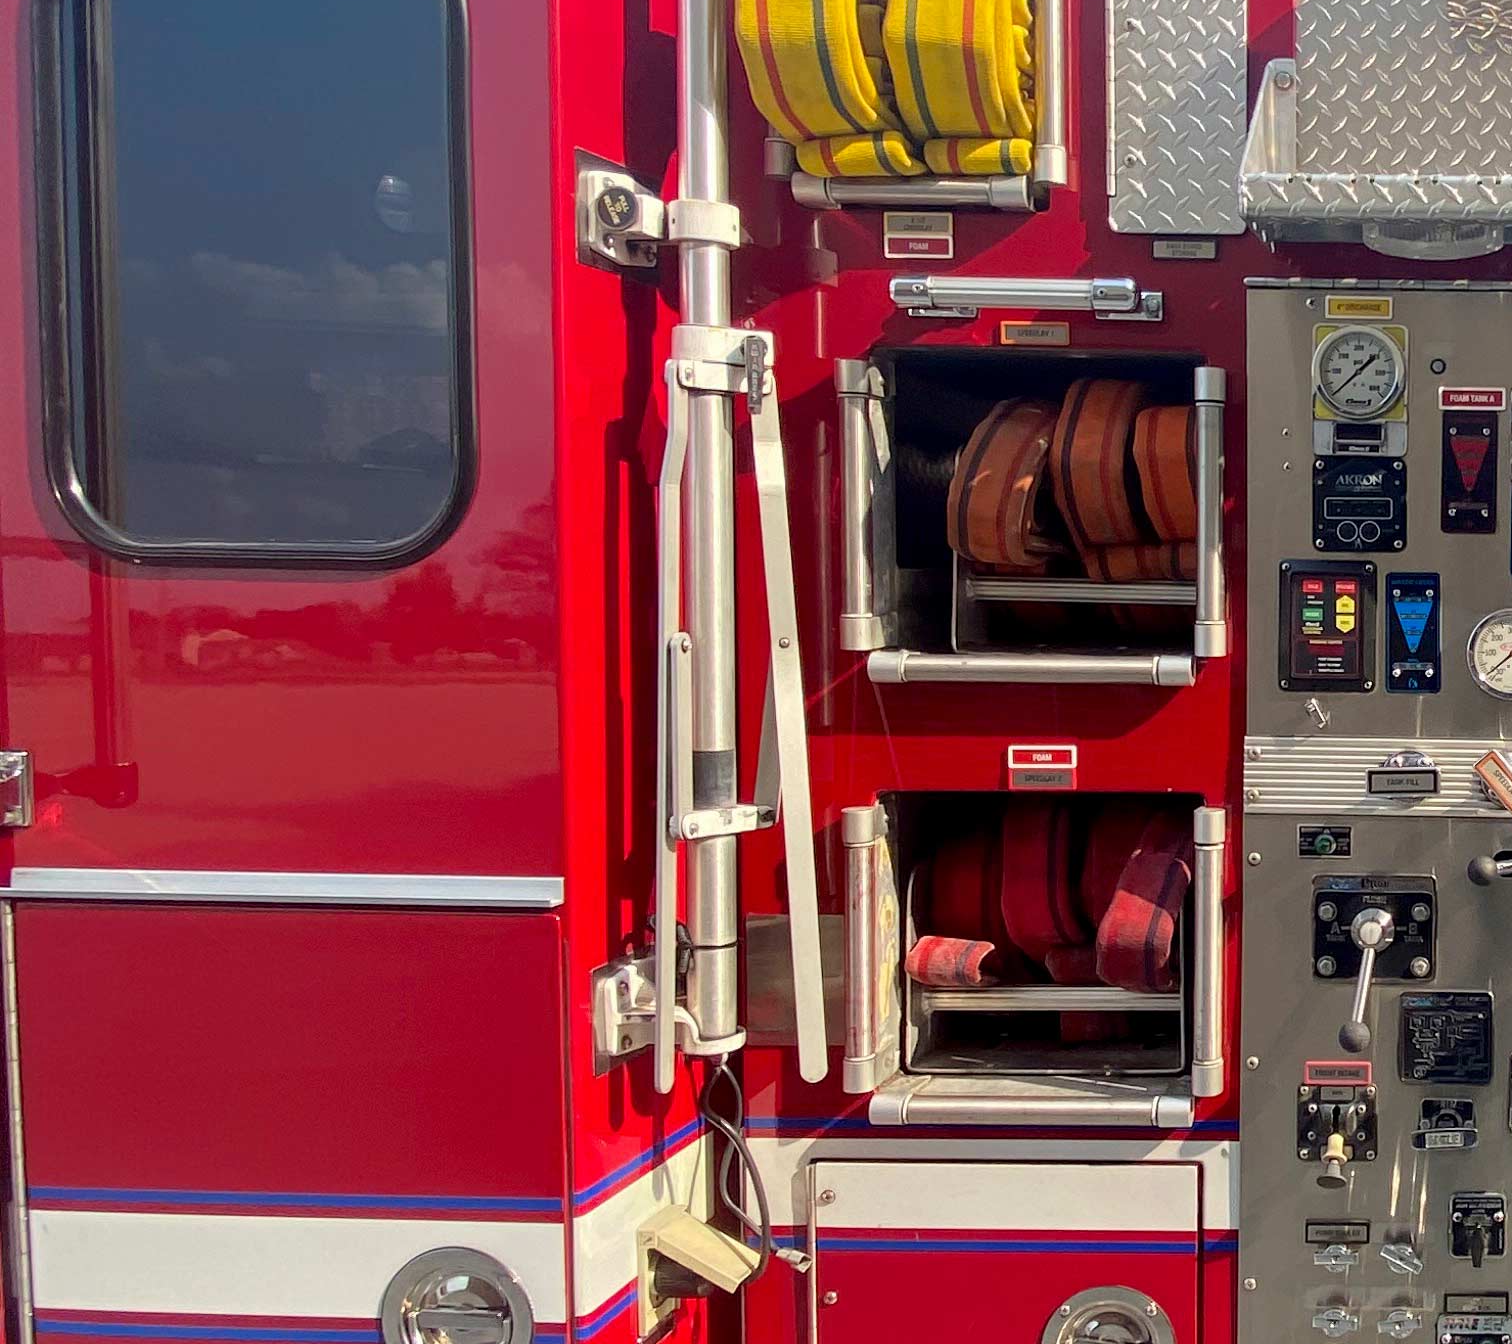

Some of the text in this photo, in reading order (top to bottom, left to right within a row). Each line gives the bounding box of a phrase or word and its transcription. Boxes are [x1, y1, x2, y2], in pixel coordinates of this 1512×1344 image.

[908, 241, 929, 251] FOAM
[1449, 394, 1495, 403] FOAM TANK A
[1335, 474, 1383, 486] AKRON
[1491, 634, 1503, 642] 200
[1485, 649, 1497, 657] 100
[1032, 753, 1053, 762] FOAM
[1404, 778, 1420, 787] FILL
[1330, 921, 1341, 935] A
[1408, 922, 1418, 935] B
